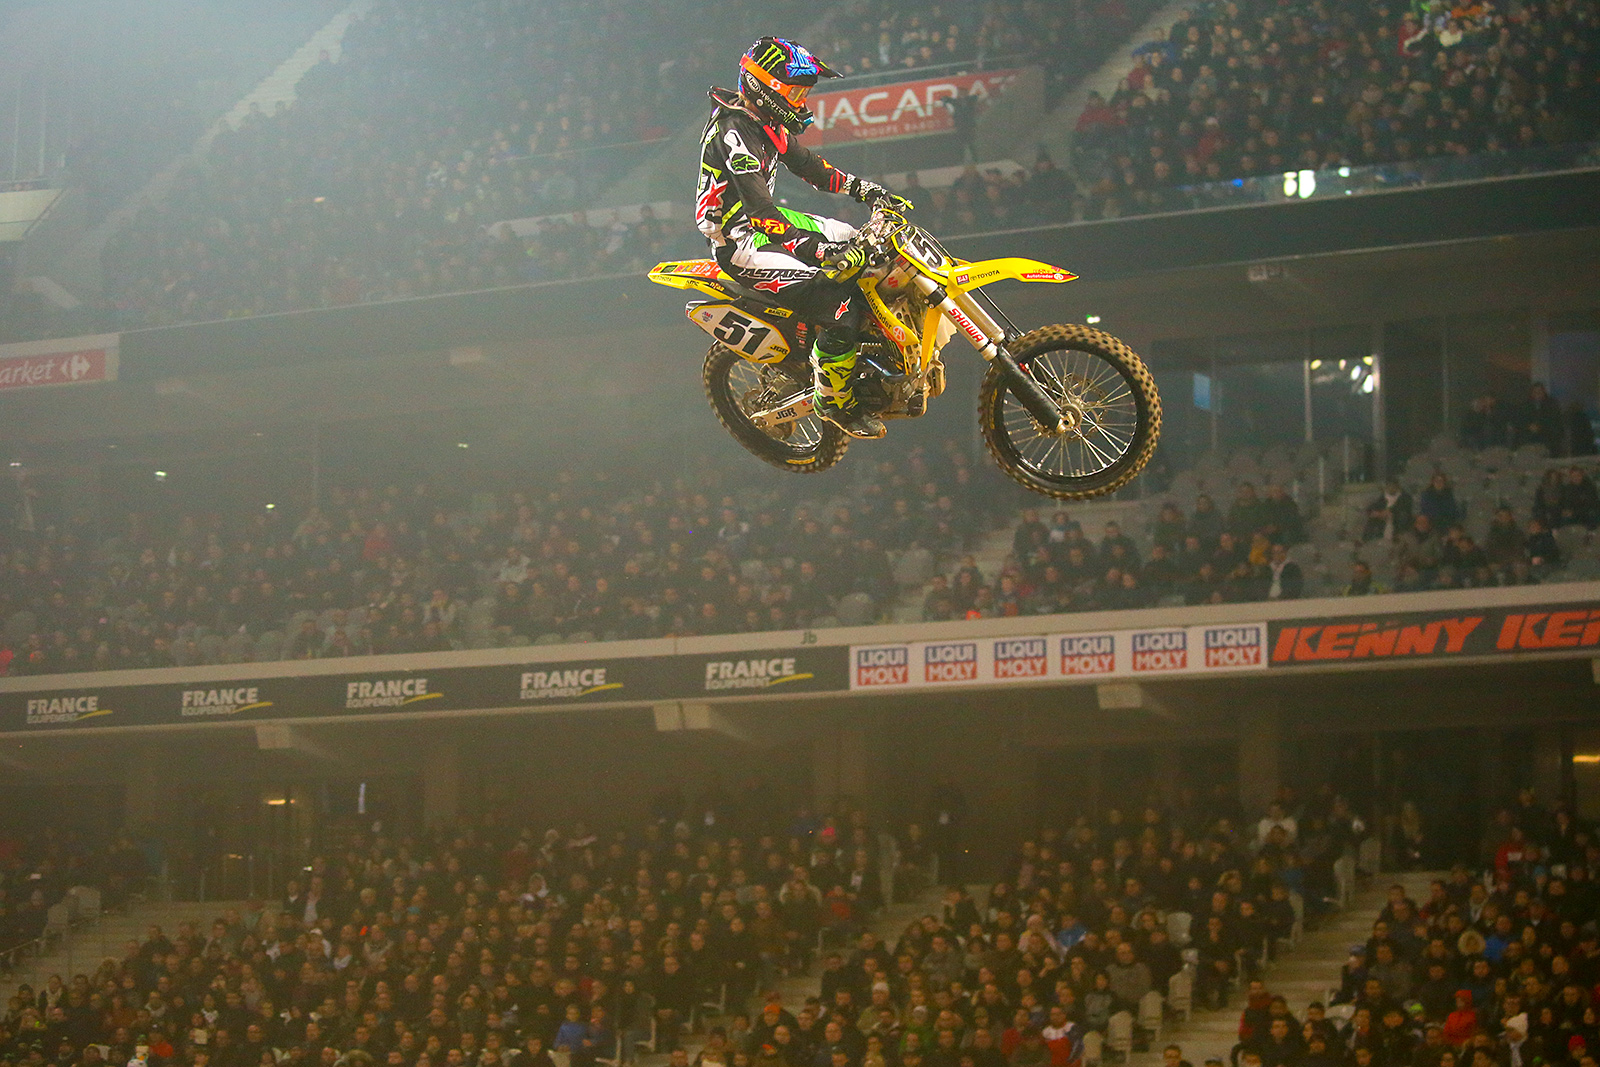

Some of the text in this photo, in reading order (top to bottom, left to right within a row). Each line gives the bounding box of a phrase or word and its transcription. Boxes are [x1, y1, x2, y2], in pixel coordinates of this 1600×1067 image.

[977, 269, 1000, 279] TOYOTA
[866, 291, 892, 330] Autotrader
[713, 311, 771, 356] 51
[948, 308, 984, 343] SHOWA
[770, 345, 788, 355] JGR
[775, 407, 797, 420] JGR
[1064, 637, 1112, 655] LIQUI
[1136, 633, 1184, 651] LIQUI
[1208, 628, 1258, 647] LIQUI
[1273, 616, 1483, 662] KENNY
[860, 650, 906, 667] LIQUI
[928, 645, 975, 663] LIQUI
[997, 641, 1044, 659] LIQUI
[1207, 647, 1259, 666] MOLY
[705, 658, 796, 680] FRANCE
[997, 659, 1045, 677] MOLY
[1064, 655, 1113, 673] MOLY
[1135, 651, 1185, 670] MOLY
[520, 668, 607, 690] FRANCE
[860, 667, 907, 685] MOLY
[928, 663, 976, 681] MOLY
[182, 687, 259, 707] FRANCE
[346, 679, 428, 699] FRANCE
[27, 696, 99, 715] FRANCE
